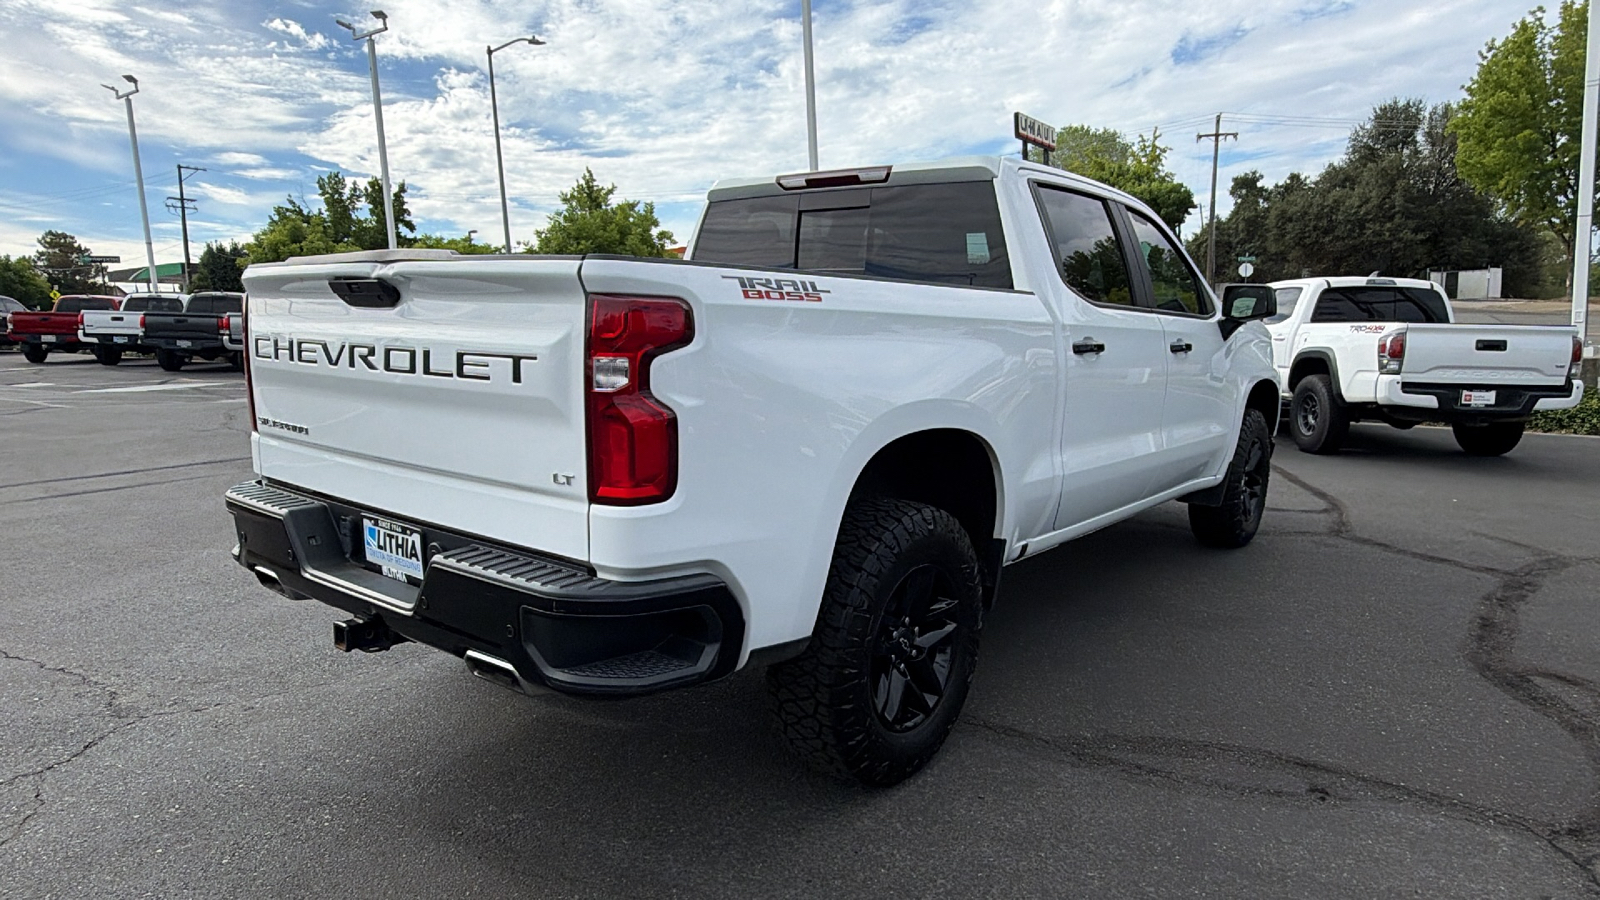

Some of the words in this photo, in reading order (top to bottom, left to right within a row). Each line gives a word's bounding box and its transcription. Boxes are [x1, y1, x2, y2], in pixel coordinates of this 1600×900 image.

[721, 275, 831, 293] TRAIL
[742, 289, 822, 302] BOSS
[254, 336, 538, 383] CHEVROLET
[1440, 371, 1535, 379] TACOMA
[553, 473, 575, 486] LT
[378, 520, 391, 530] SINCE
[377, 529, 420, 562] LITHIA
[367, 547, 386, 561] TOYOTA
[386, 554, 394, 563] OF
[394, 557, 421, 572] REDDING
